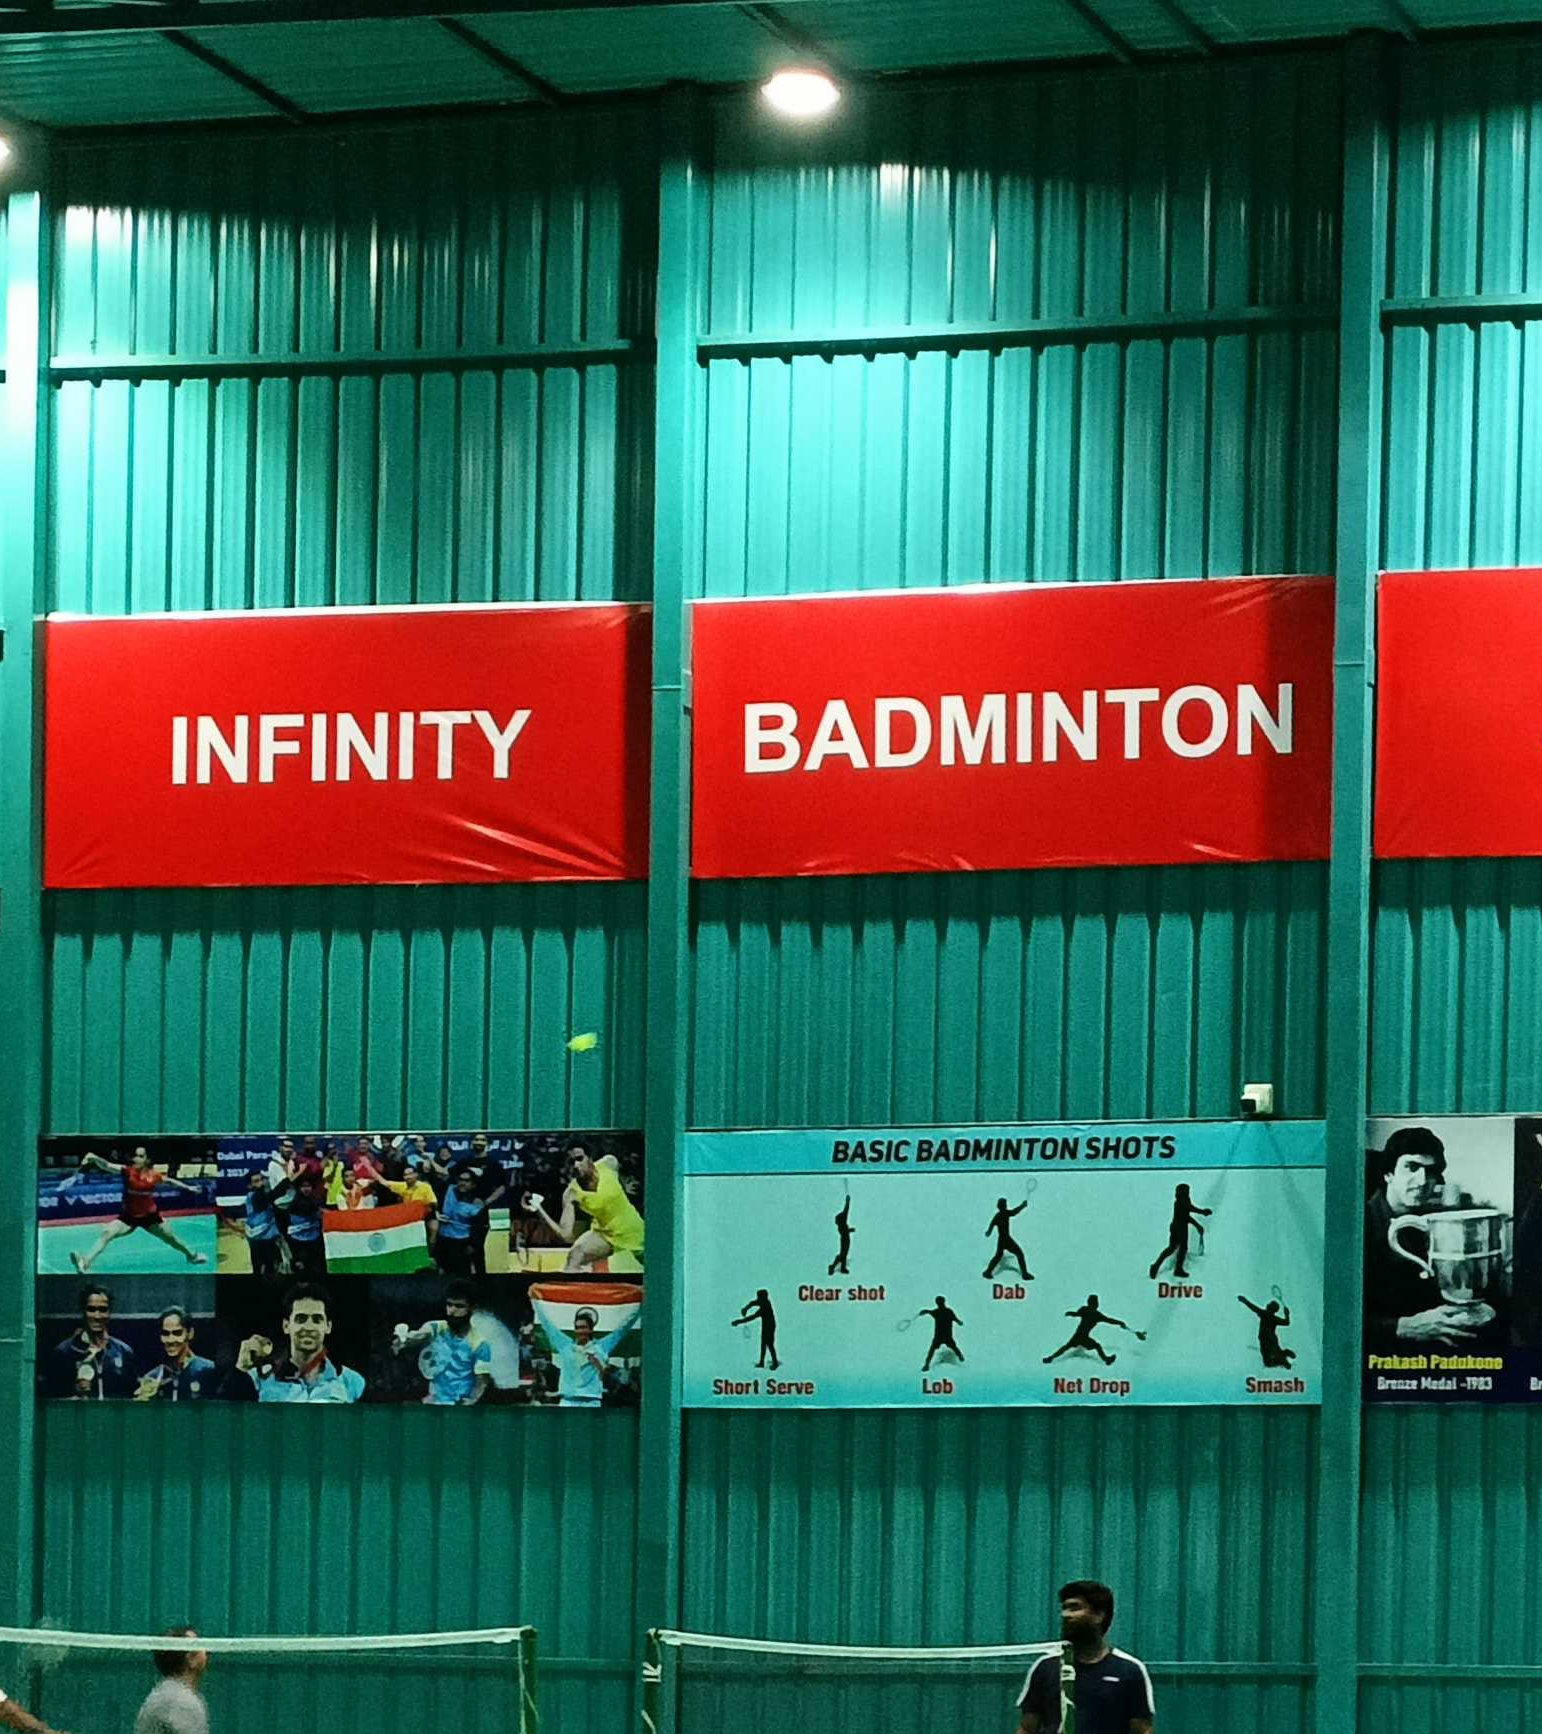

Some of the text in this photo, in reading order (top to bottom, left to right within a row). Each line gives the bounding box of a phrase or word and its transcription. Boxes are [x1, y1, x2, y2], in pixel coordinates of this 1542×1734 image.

[743, 683, 1294, 773] BADMINTON
[171, 709, 533, 785] INFINITY
[831, 1135, 1176, 1163] BASIC BADMINTON SHOTS
[798, 1285, 885, 1301] Clear shot
[992, 1283, 1025, 1300] Dab
[1158, 1282, 1203, 1298] Drive
[1368, 1354, 1503, 1370] Prakash Padukone
[712, 1378, 814, 1395] Short Serve
[922, 1378, 953, 1394] Lob
[1053, 1377, 1130, 1396] Net Drop
[1245, 1376, 1304, 1393] Smash
[1377, 1376, 1418, 1390] Bronze
[1421, 1376, 1457, 1390] Medal
